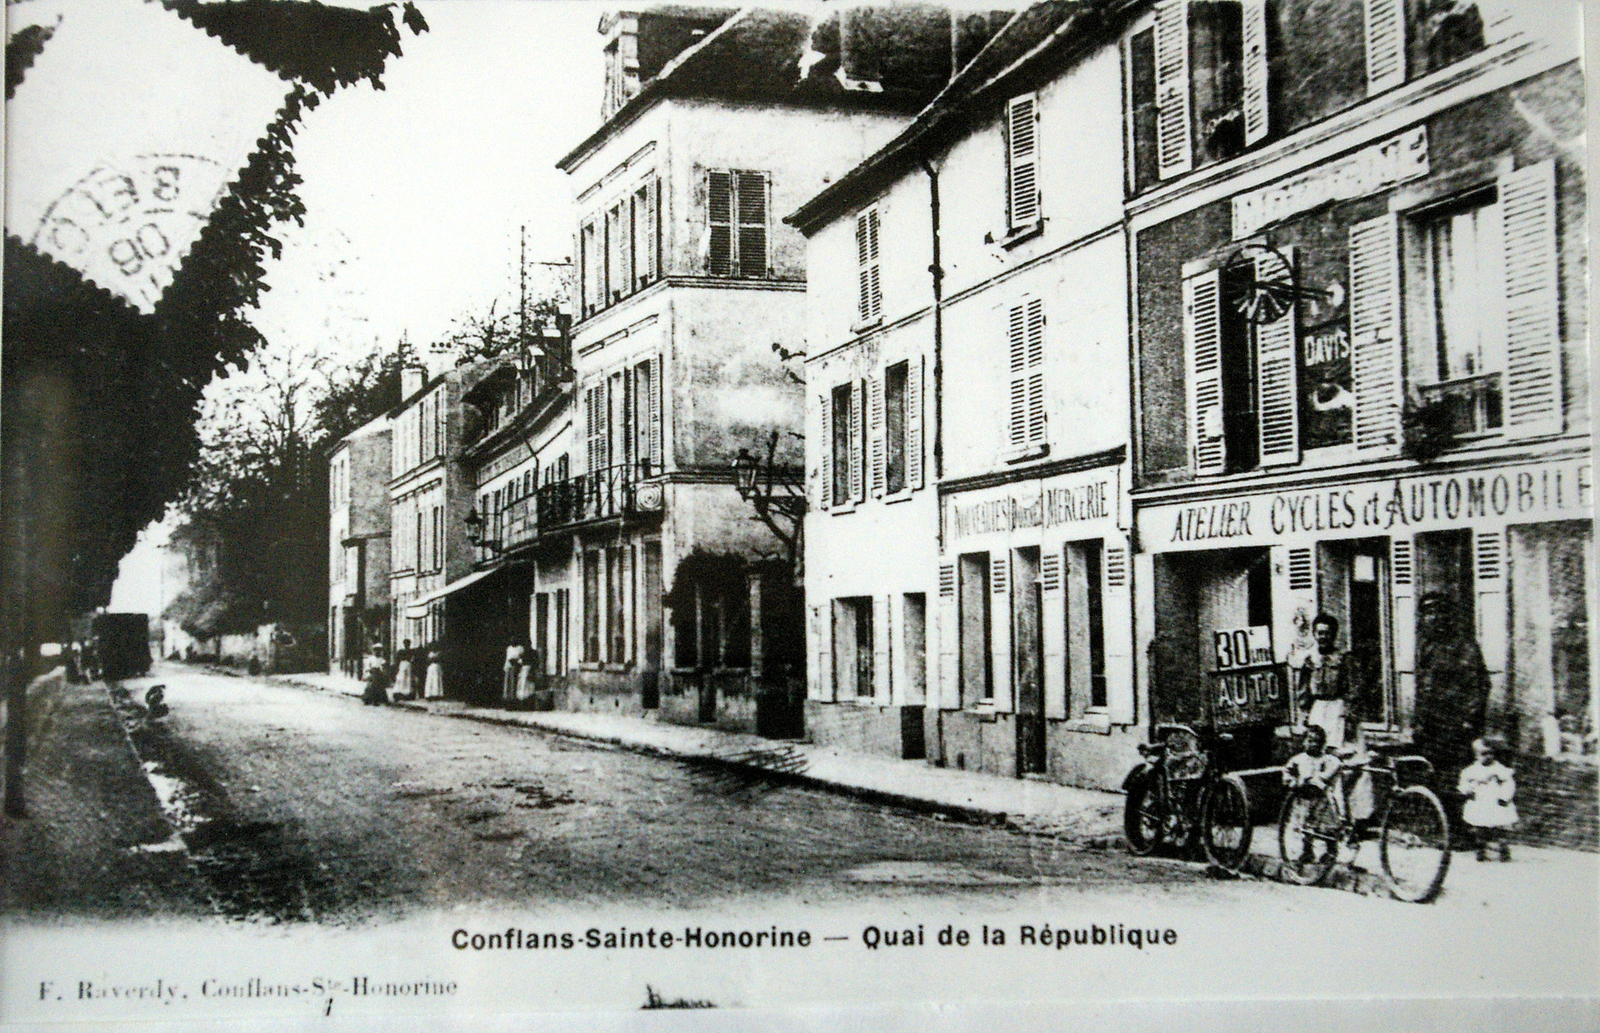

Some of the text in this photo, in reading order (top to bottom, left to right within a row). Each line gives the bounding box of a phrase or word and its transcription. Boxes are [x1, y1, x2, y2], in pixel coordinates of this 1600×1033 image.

[1047, 481, 1109, 529] MERCERIE
[1171, 500, 1252, 542] ATELIER
[1271, 490, 1356, 535] CYCLES
[1219, 672, 1279, 707] AUTO
